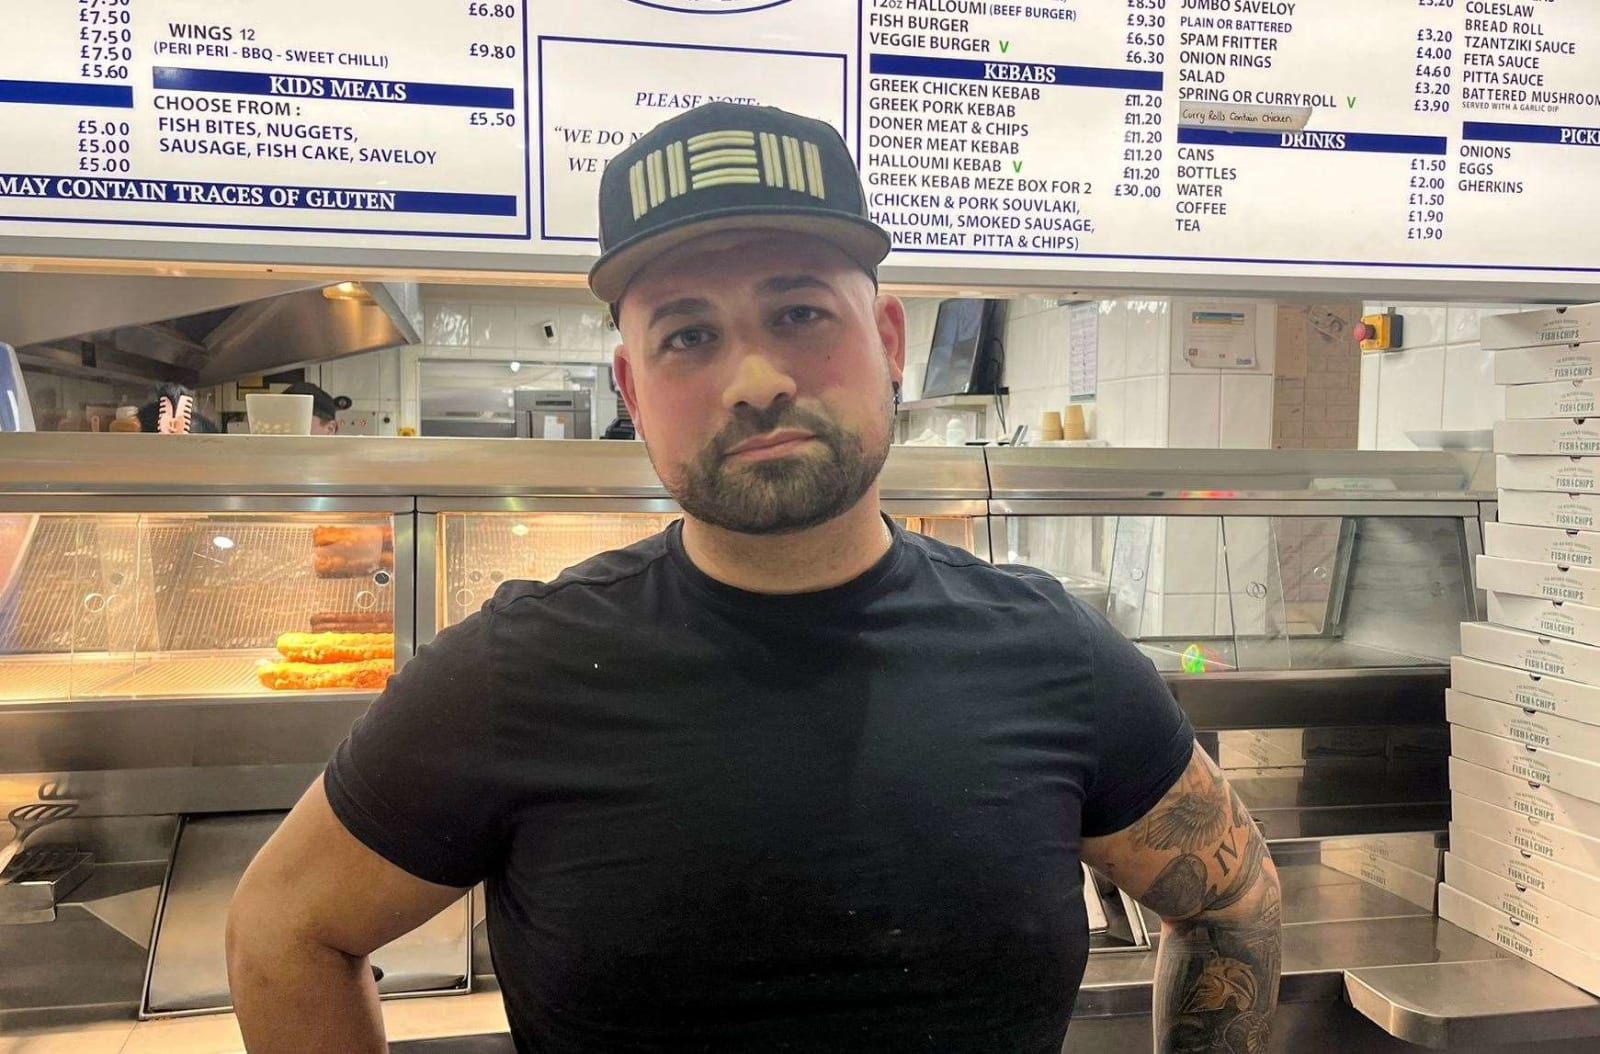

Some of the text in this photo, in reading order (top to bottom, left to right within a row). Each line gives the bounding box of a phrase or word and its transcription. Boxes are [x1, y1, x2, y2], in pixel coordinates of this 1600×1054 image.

[468, 3, 515, 18] £6.80
[906, 0, 986, 15] HALLOUMI
[989, 5, 1022, 17] (BEEF
[1025, 7, 1077, 21] BURGER)
[1234, 0, 1296, 16] SAVELOY
[1466, 1, 1534, 17] COLESLAW
[80, 9, 130, 25] £7.50
[870, 13, 969, 32] FISH BURGER
[1127, 14, 1165, 28] £9.30
[1180, 16, 1293, 33] PLAIN OR BATTERED
[169, 23, 255, 41] WINGS 12
[1465, 19, 1544, 36] BREAD ROLL
[80, 27, 131, 44] £7.50
[870, 32, 1010, 54] VEGGIE BURGER V
[1126, 32, 1165, 47] £6.50
[1180, 33, 1277, 51] SPAM FRITTER
[1417, 29, 1452, 43] £3.20
[470, 43, 515, 59] £9.80
[1465, 35, 1576, 55] TZANTZIKI SAUCE
[80, 45, 132, 61] £7.50
[153, 41, 388, 69] (PERI PERI BBQ SWEET CHILLI)
[1126, 51, 1164, 65] £6.30
[1180, 51, 1272, 69] ONION RINGS
[1416, 47, 1452, 60] £4.00
[1464, 53, 1539, 69] FETA SAUCE
[81, 64, 128, 79] £5.60
[984, 63, 1056, 83] KEBABS
[1179, 69, 1225, 83] SALAD
[1416, 65, 1451, 77] £4.60
[1463, 71, 1544, 87] PITTA SAUCE
[269, 76, 407, 101] KIDS MEALS
[870, 78, 1041, 101] GREEK CHICKEN KEBAB
[1179, 87, 1229, 102] SPRING
[1233, 90, 1252, 103] OR
[1415, 82, 1450, 95] £3.20
[1463, 87, 1527, 102] BATTERED
[153, 95, 232, 113] CHOOSE
[870, 97, 1016, 118] GREEK PORK KEBAB
[1125, 94, 1162, 109] £11.20
[1414, 100, 1450, 112] £3.90
[1462, 101, 1489, 109] SERVED
[1492, 103, 1510, 111] WITH
[1520, 104, 1545, 112] GARLIC
[1548, 105, 1559, 113] DIP
[470, 113, 515, 127] £5.50
[870, 116, 1029, 137] DONER MEAT & CHIPS
[1125, 113, 1162, 126] £11.20
[78, 120, 130, 136] £5.00
[159, 117, 358, 143] FISH BITES, NUGGETS,
[597, 130, 624, 145] DO
[1124, 131, 1162, 144] £11.20
[1280, 132, 1346, 149] DRINKS
[1560, 128, 1600, 145] PICK
[78, 139, 130, 154] £5.00
[159, 138, 436, 164] SAUSAGE, FISH CAKE, SAVELOY
[870, 135, 1019, 155] DONER MEAT KEBAB
[1460, 145, 1511, 159] ONIONS
[1123, 149, 1162, 162] £11.20
[1178, 148, 1214, 161] CANS
[79, 157, 130, 172] £5.00
[568, 158, 597, 172] WE
[869, 154, 1023, 174] HALLOUMI KEBAB V
[1411, 159, 1446, 171] £1.50
[1459, 162, 1493, 175] EGGS
[1123, 167, 1160, 180] £11.20
[1177, 166, 1237, 180] BOTTLES
[868, 173, 1092, 194] GREEK KEBAB MEZE BOX FOR 2
[1177, 183, 1222, 197] WATER
[1410, 176, 1445, 189] £2.00
[1458, 180, 1524, 194] GHERKINS
[0, 177, 396, 210] MAY CONTAIN TRACES OF GLUTEN
[1115, 184, 1161, 198] £30.00
[869, 193, 1080, 216] (CHICKEN & PORK SOUVLAKI,
[1409, 193, 1444, 206] £1.50
[1176, 201, 1227, 215] COFFEE
[870, 212, 1095, 234] HALLOUMI, SMOKED SAUSAGE,
[1408, 210, 1443, 223] £1.90
[1176, 219, 1200, 232] TEA
[892, 231, 1079, 251] NER MEAT PITTA & CHIPS)
[1408, 227, 1442, 240] £1.90
